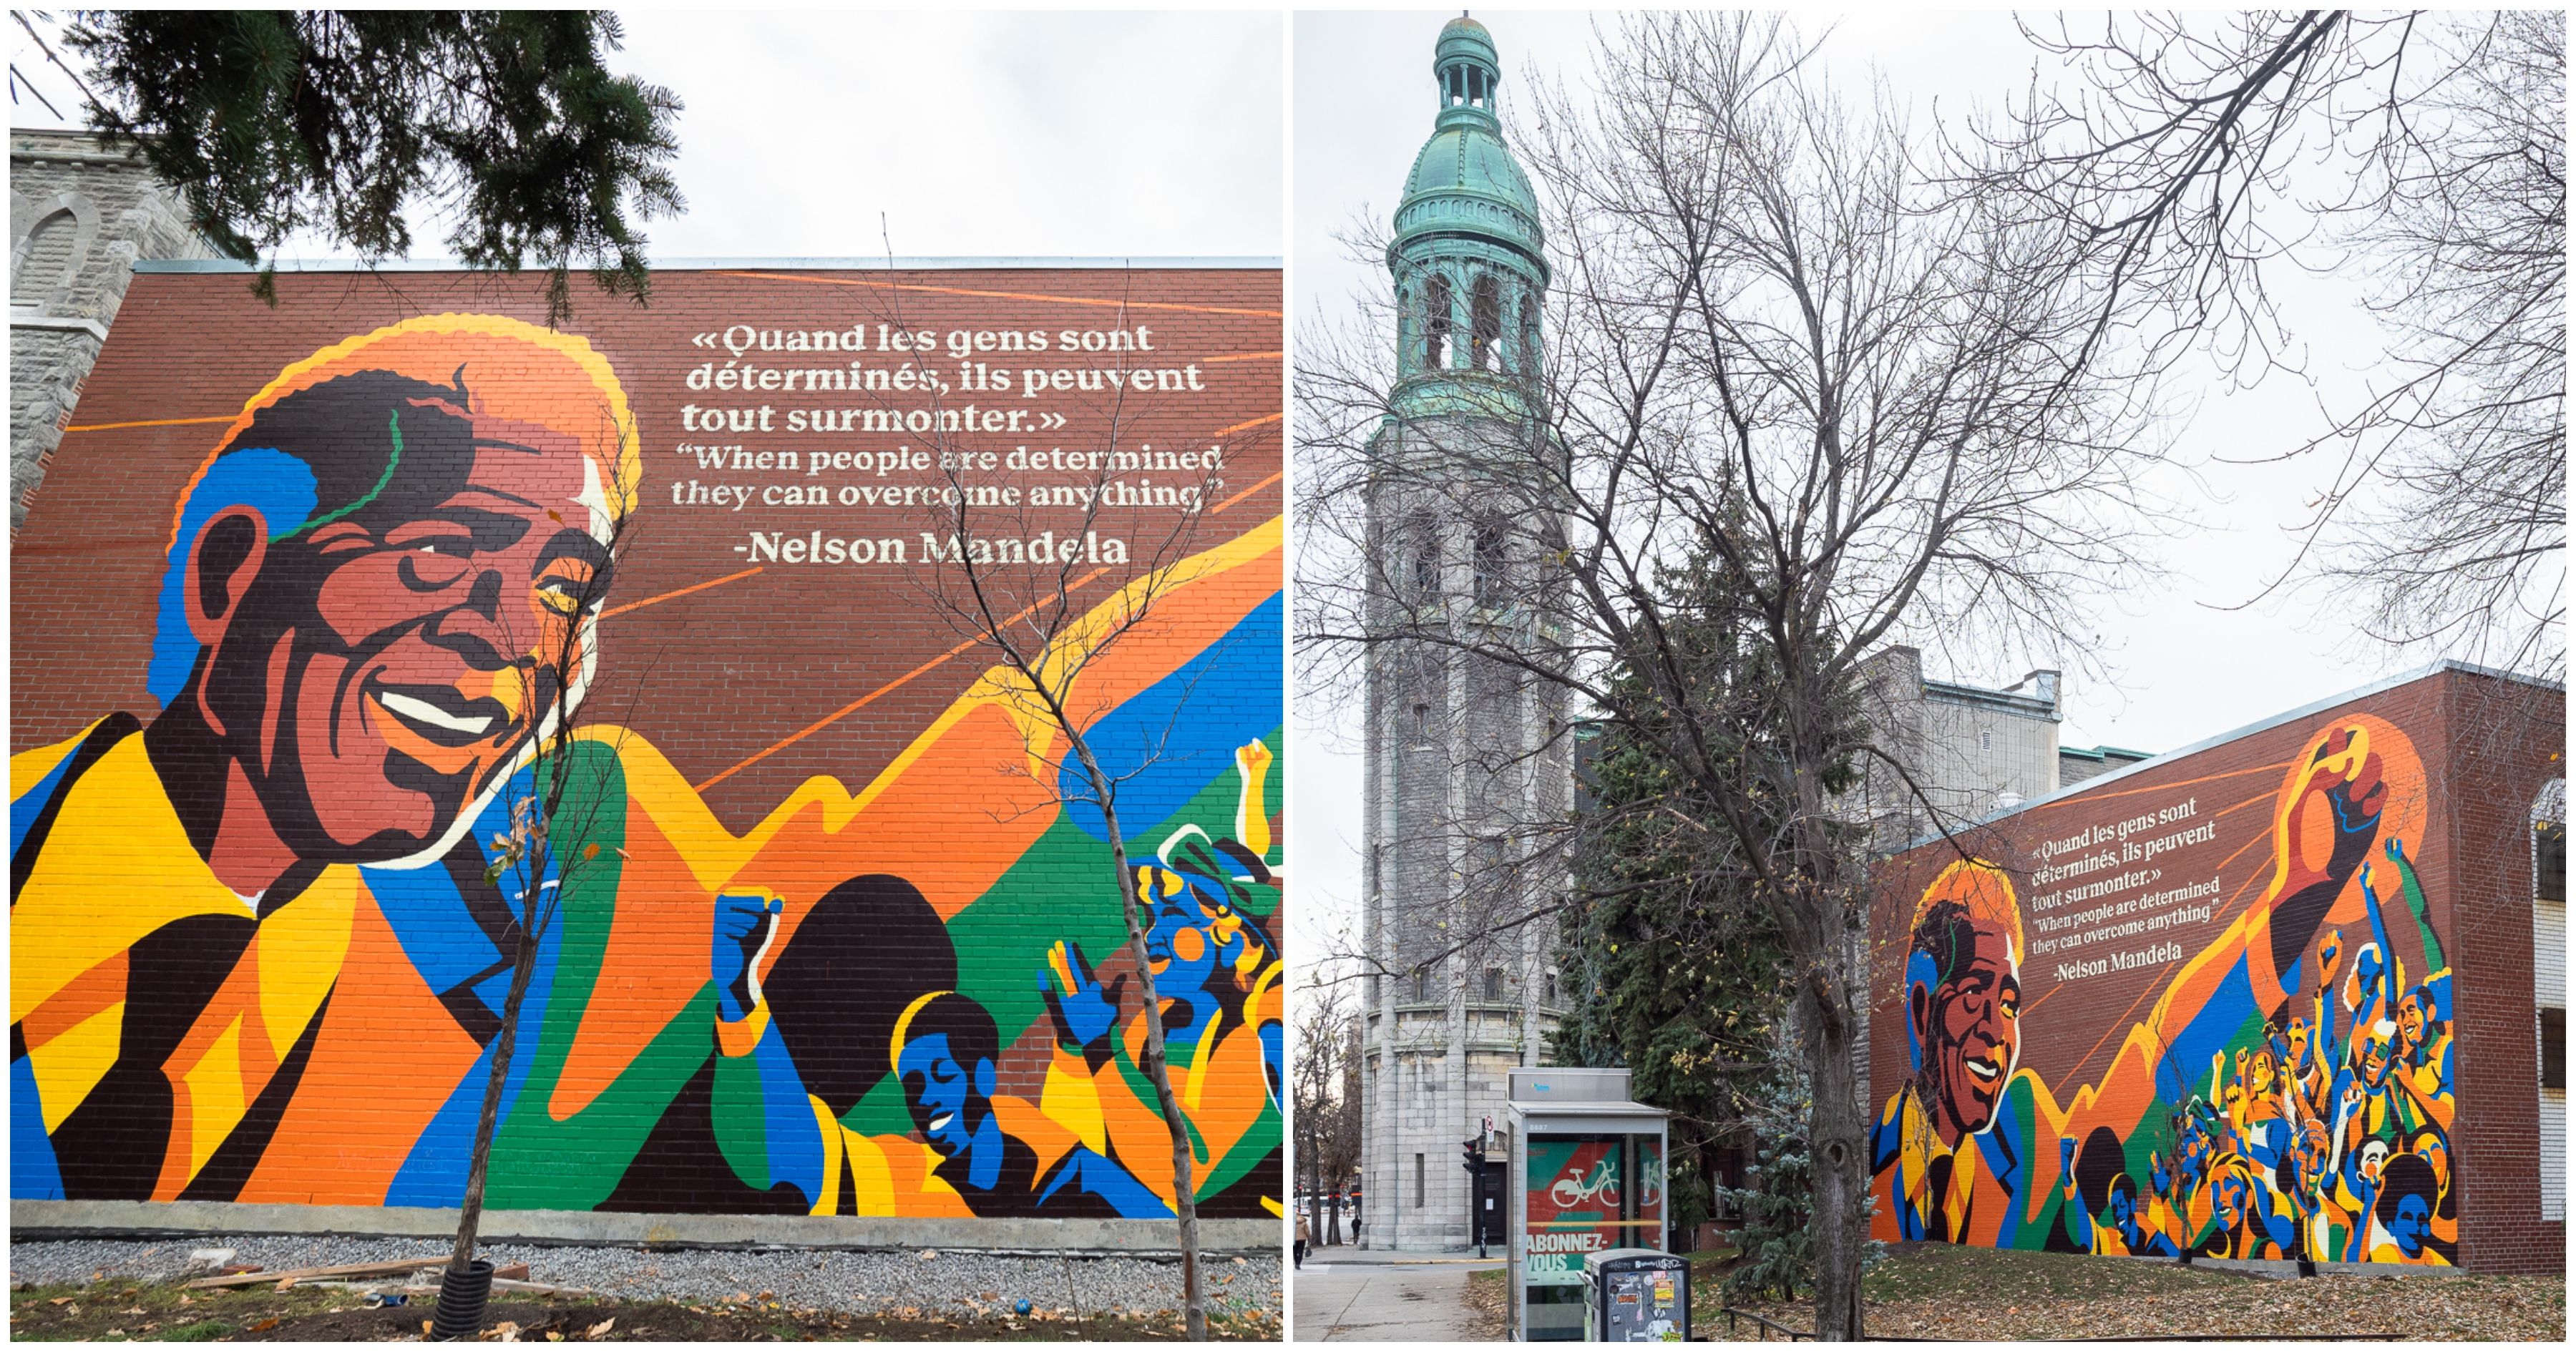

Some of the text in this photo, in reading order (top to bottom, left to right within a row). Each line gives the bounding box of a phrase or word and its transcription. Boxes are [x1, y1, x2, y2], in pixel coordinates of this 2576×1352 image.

[691, 323, 1155, 358] «Quand les gens sont
[686, 360, 1205, 398] déterminés, ils peuvent
[680, 403, 1067, 433] tout surmonter.»
[806, 446, 930, 476] people
[940, 450, 997, 471] are
[1005, 444, 1225, 471] determined
[671, 480, 756, 511] they
[762, 484, 835, 506] can
[839, 484, 1021, 506] overcome
[733, 530, 1130, 564] -Nelson Mandela
[2093, 824, 2114, 844] les
[2117, 810, 2156, 841] gens
[2159, 797, 2197, 825] sont
[2031, 820, 2215, 887] déterminés, ils peuvent
[2031, 868, 2162, 913] tout surmonter.»
[2073, 903, 2114, 929] people
[2116, 901, 2137, 915] are
[2139, 876, 2220, 911] determined
[2032, 936, 2064, 955] they
[2060, 933, 2082, 949] can
[2084, 920, 2145, 944] overcome
[2053, 941, 2182, 982] -Nelson Mandela
[1526, 1233, 1608, 1252] ABONNEZ-
[1526, 1253, 1567, 1271] VOUS
